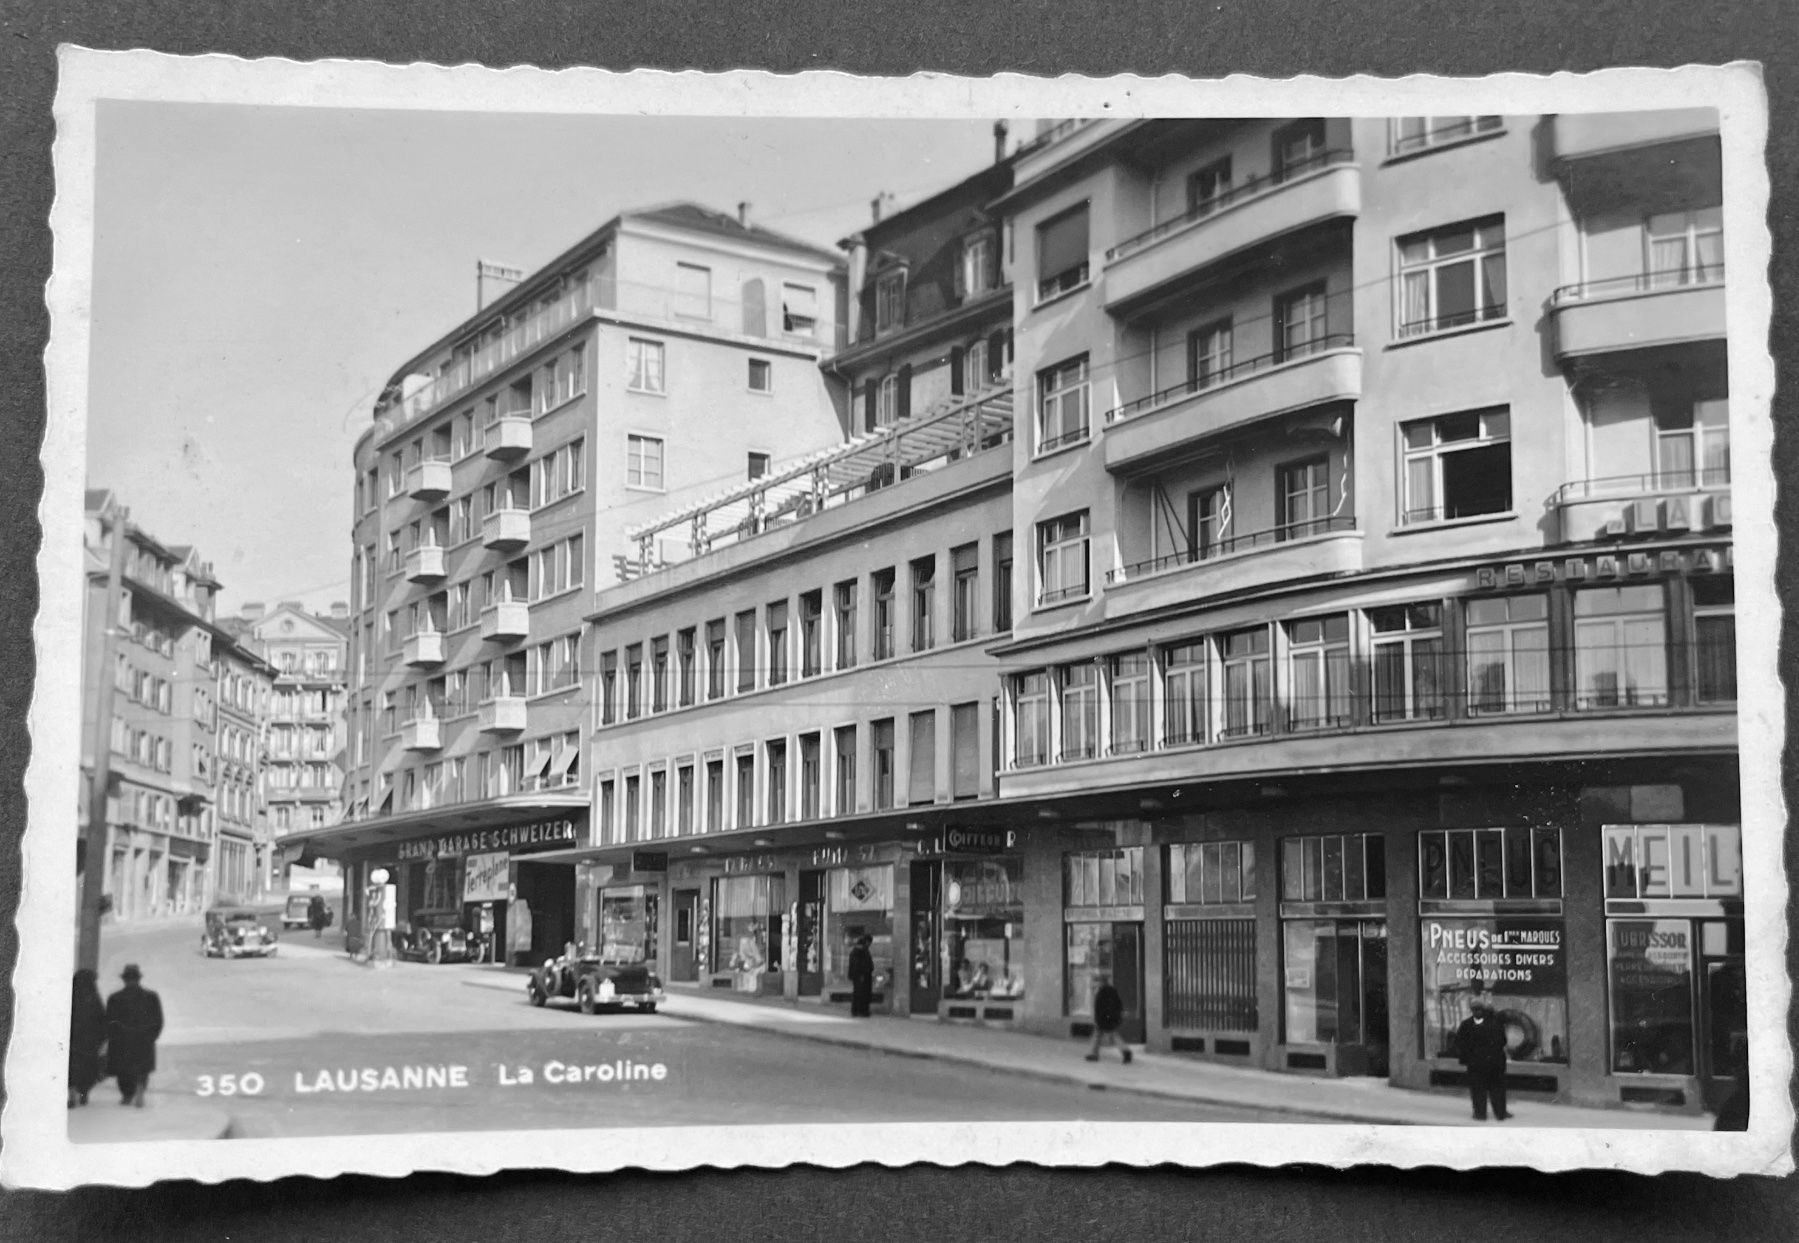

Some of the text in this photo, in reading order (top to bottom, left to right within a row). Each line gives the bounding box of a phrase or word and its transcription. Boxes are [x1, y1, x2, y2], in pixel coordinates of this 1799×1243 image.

[492, 820, 573, 848] SCHWEIZER
[1430, 923, 1490, 949] PNEUS
[1491, 934, 1503, 943] DE
[1520, 930, 1560, 944] MARQUES
[1437, 949, 1554, 966] ACCESSOIRES DIVERS
